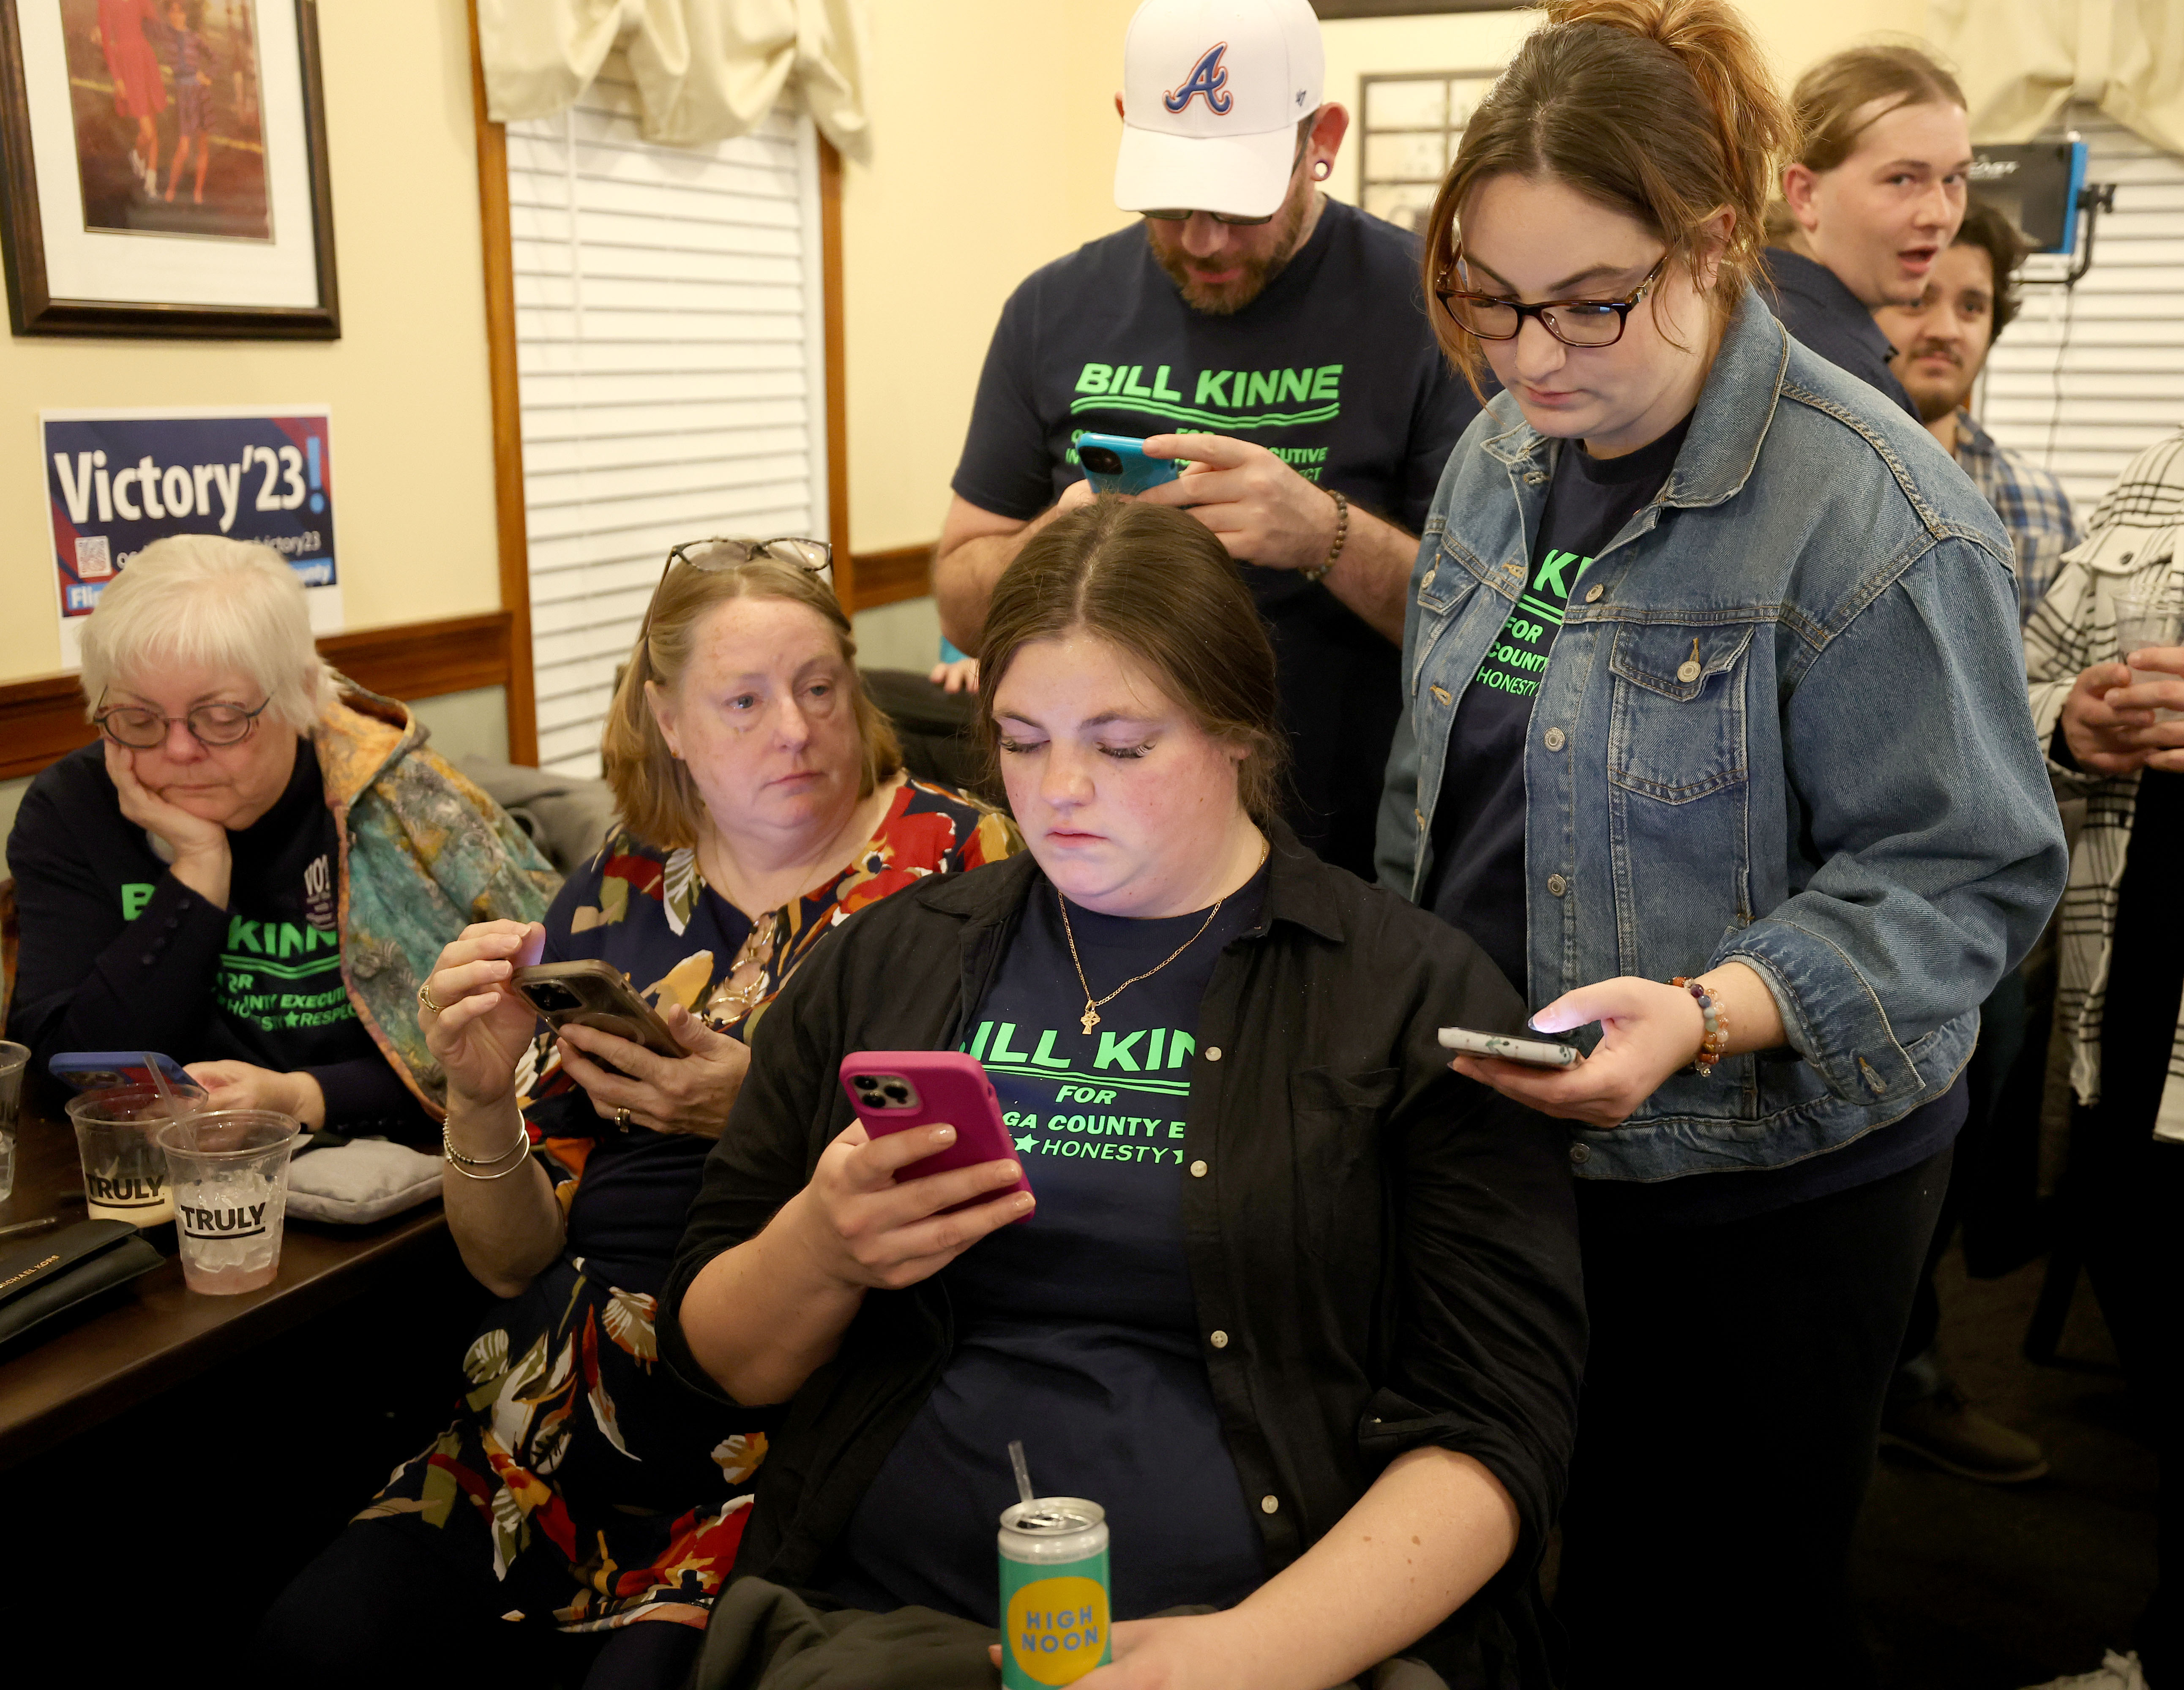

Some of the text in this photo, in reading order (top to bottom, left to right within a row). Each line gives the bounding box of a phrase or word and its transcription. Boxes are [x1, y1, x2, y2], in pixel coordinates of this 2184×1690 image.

[1163, 41, 1233, 115] A
[1074, 363, 1344, 408] BILL KINNE
[1476, 666, 1540, 697] HONESTY
[959, 1021, 1071, 1069] ILL
[1055, 1085, 1117, 1104] FOR
[1048, 1115, 1161, 1137] COUNTY
[1041, 1139, 1169, 1164] HONESTY
[87, 1175, 164, 1200] TRULY
[180, 1202, 266, 1231] TRULY
[34, 1255, 60, 1269] KORS
[1026, 1605, 1093, 1630] HIGH
[1021, 1625, 1099, 1653] NOON
